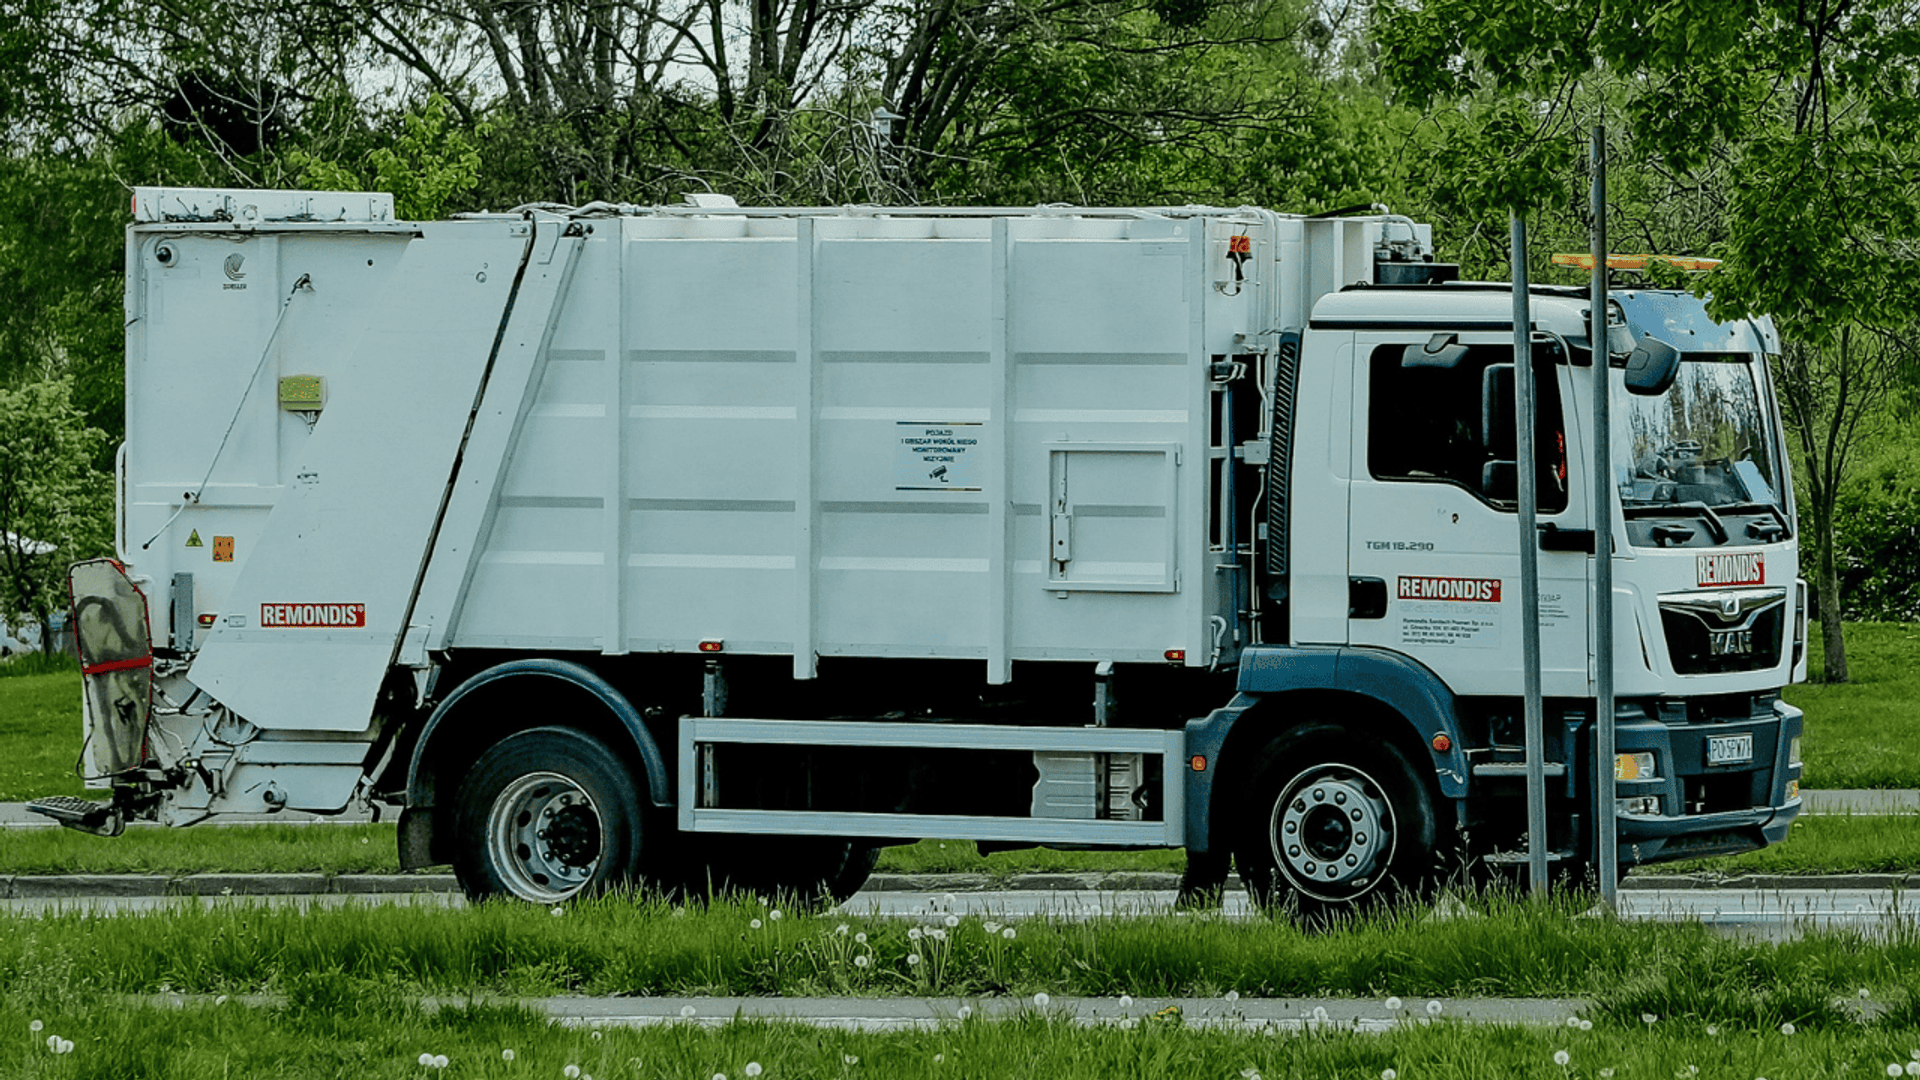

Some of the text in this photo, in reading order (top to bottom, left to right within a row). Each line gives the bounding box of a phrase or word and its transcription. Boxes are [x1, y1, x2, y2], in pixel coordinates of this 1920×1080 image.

[1366, 541, 1435, 551] TGM 18.290
[1709, 631, 1753, 656] MAN
[1712, 739, 1726, 760] PO
